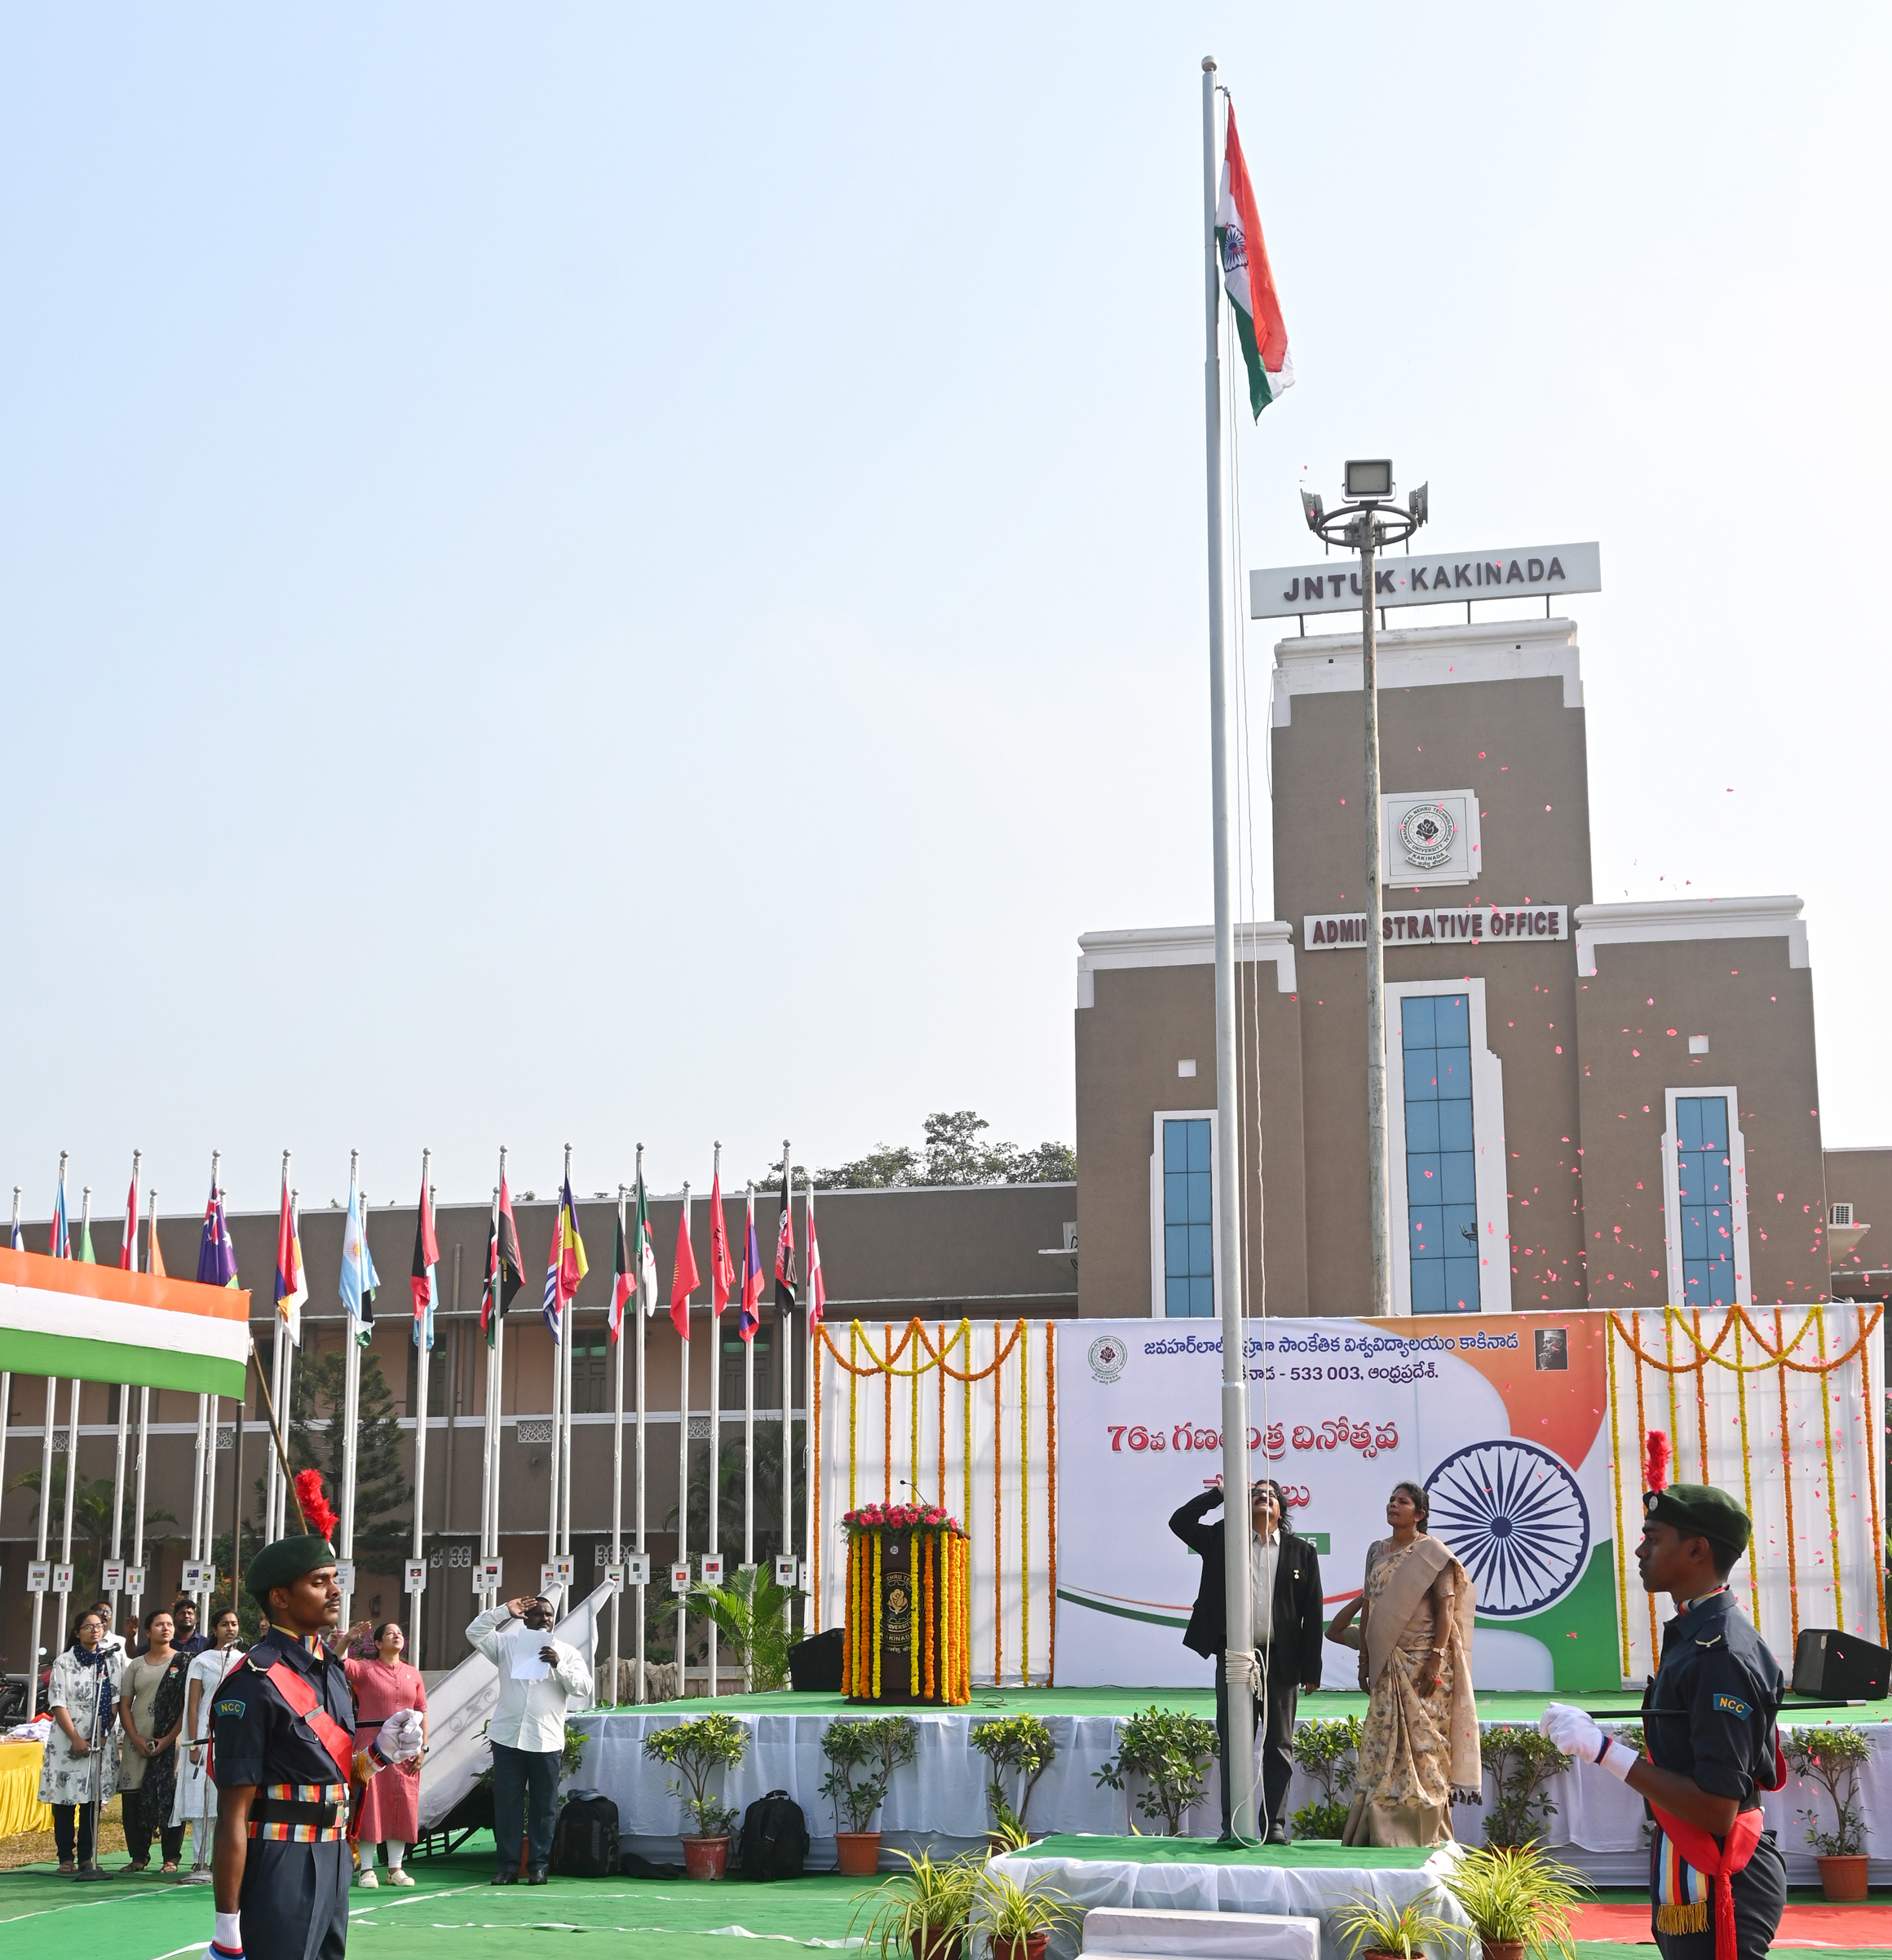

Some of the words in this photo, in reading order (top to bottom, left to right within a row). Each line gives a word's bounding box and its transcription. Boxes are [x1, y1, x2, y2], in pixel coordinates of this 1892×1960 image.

[1284, 570, 1396, 602] JNTUK
[1411, 557, 1566, 591] KAKINADA
[1433, 807, 1452, 845] TECHNOLOGICAL
[1412, 844, 1443, 853] UNIVERSITY
[1412, 853, 1444, 861] KAKINADA
[1313, 915, 1483, 943] ADMISTRATIVE
[1490, 912, 1559, 936] OFFICE
[1279, 1333, 1340, 1353] సాంకేతిక
[1345, 1335, 1456, 1358] విశ్వవిద్యాలయం
[1459, 1331, 1519, 1350] కాకినాడ
[1290, 1366, 1323, 1381] 533
[1327, 1366, 1364, 1381] 003,
[1368, 1361, 1439, 1384] ఆంధ్రప్రదేశ్.
[1172, 1422, 1286, 1460] గణంత్ర
[1292, 1416, 1399, 1459] దినోత్సవ
[221, 1703, 241, 1712] NCC
[1720, 1697, 1744, 1713] NCC
